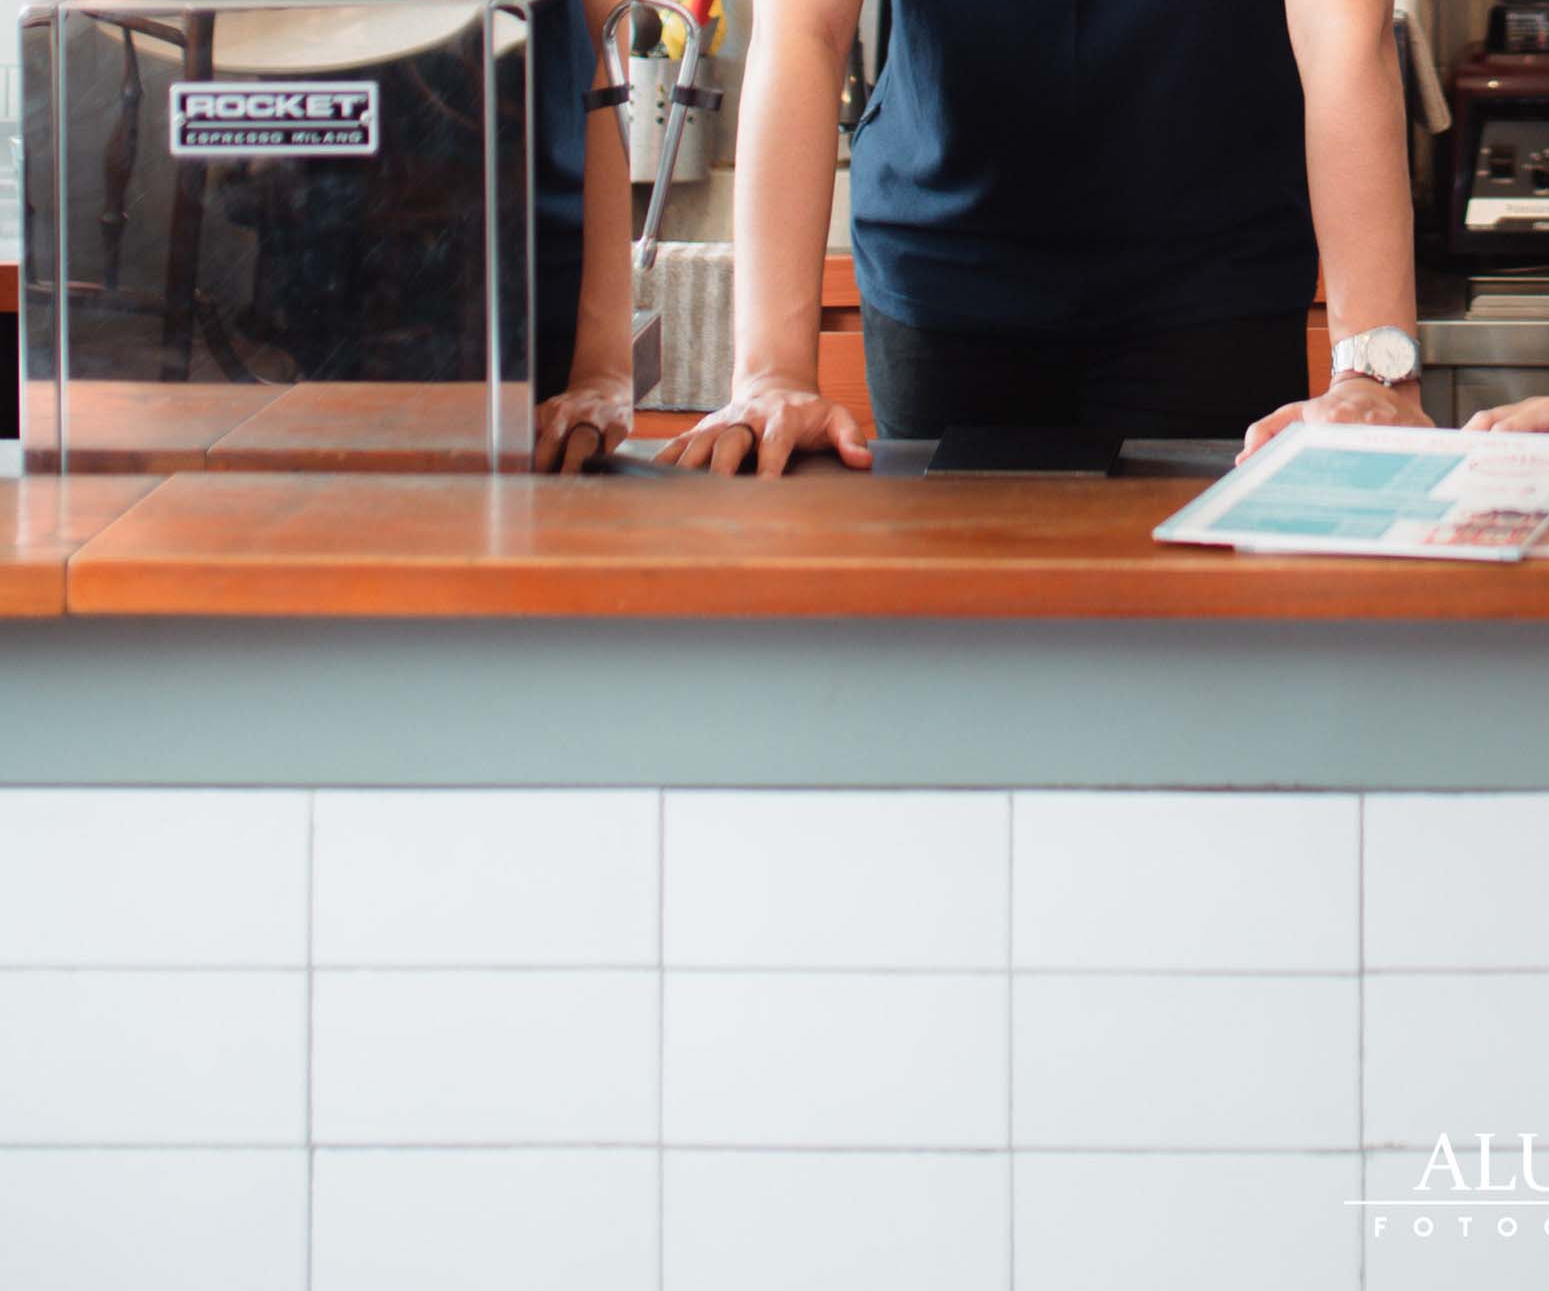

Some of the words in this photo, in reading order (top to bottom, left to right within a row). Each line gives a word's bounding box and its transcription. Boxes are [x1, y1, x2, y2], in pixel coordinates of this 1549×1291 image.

[186, 94, 357, 118] ROCKET
[186, 131, 284, 145] ESPRESSO
[291, 131, 363, 144] MILANO
